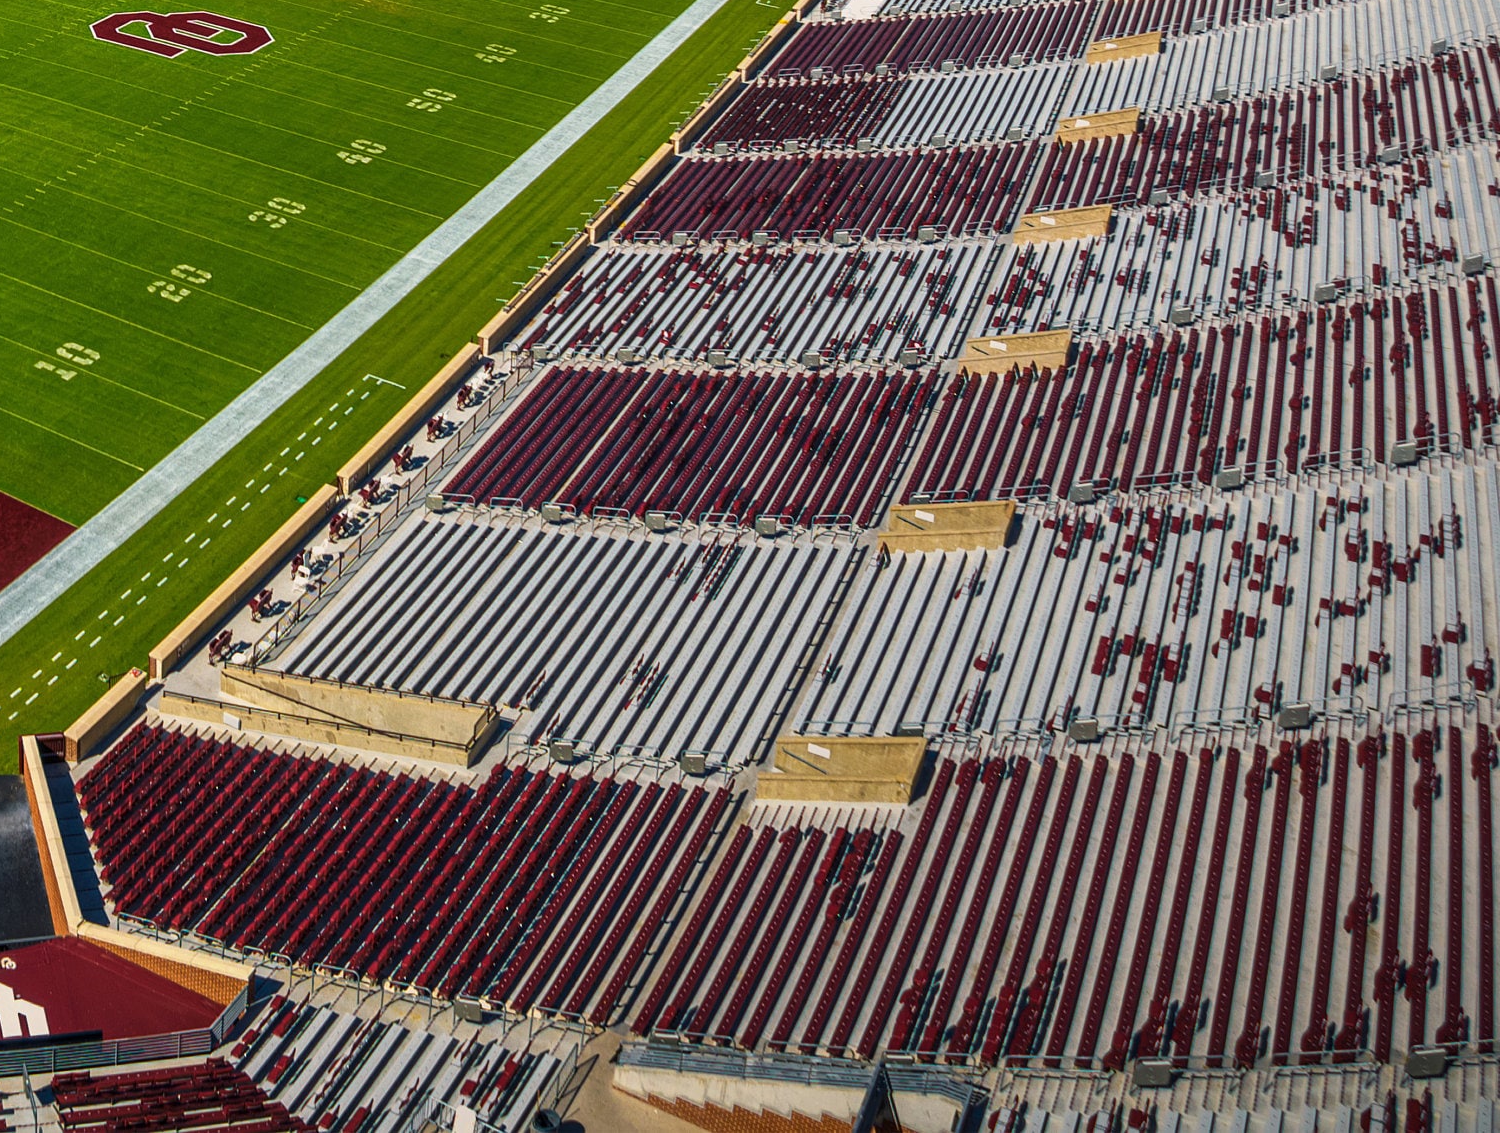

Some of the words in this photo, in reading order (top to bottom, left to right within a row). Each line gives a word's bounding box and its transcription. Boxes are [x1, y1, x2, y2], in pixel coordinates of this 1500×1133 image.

[475, 44, 517, 63] 40
[406, 88, 457, 112] 50
[336, 139, 387, 165] 40
[248, 197, 306, 229] 30
[147, 264, 212, 303] 20
[34, 342, 101, 381] 10
